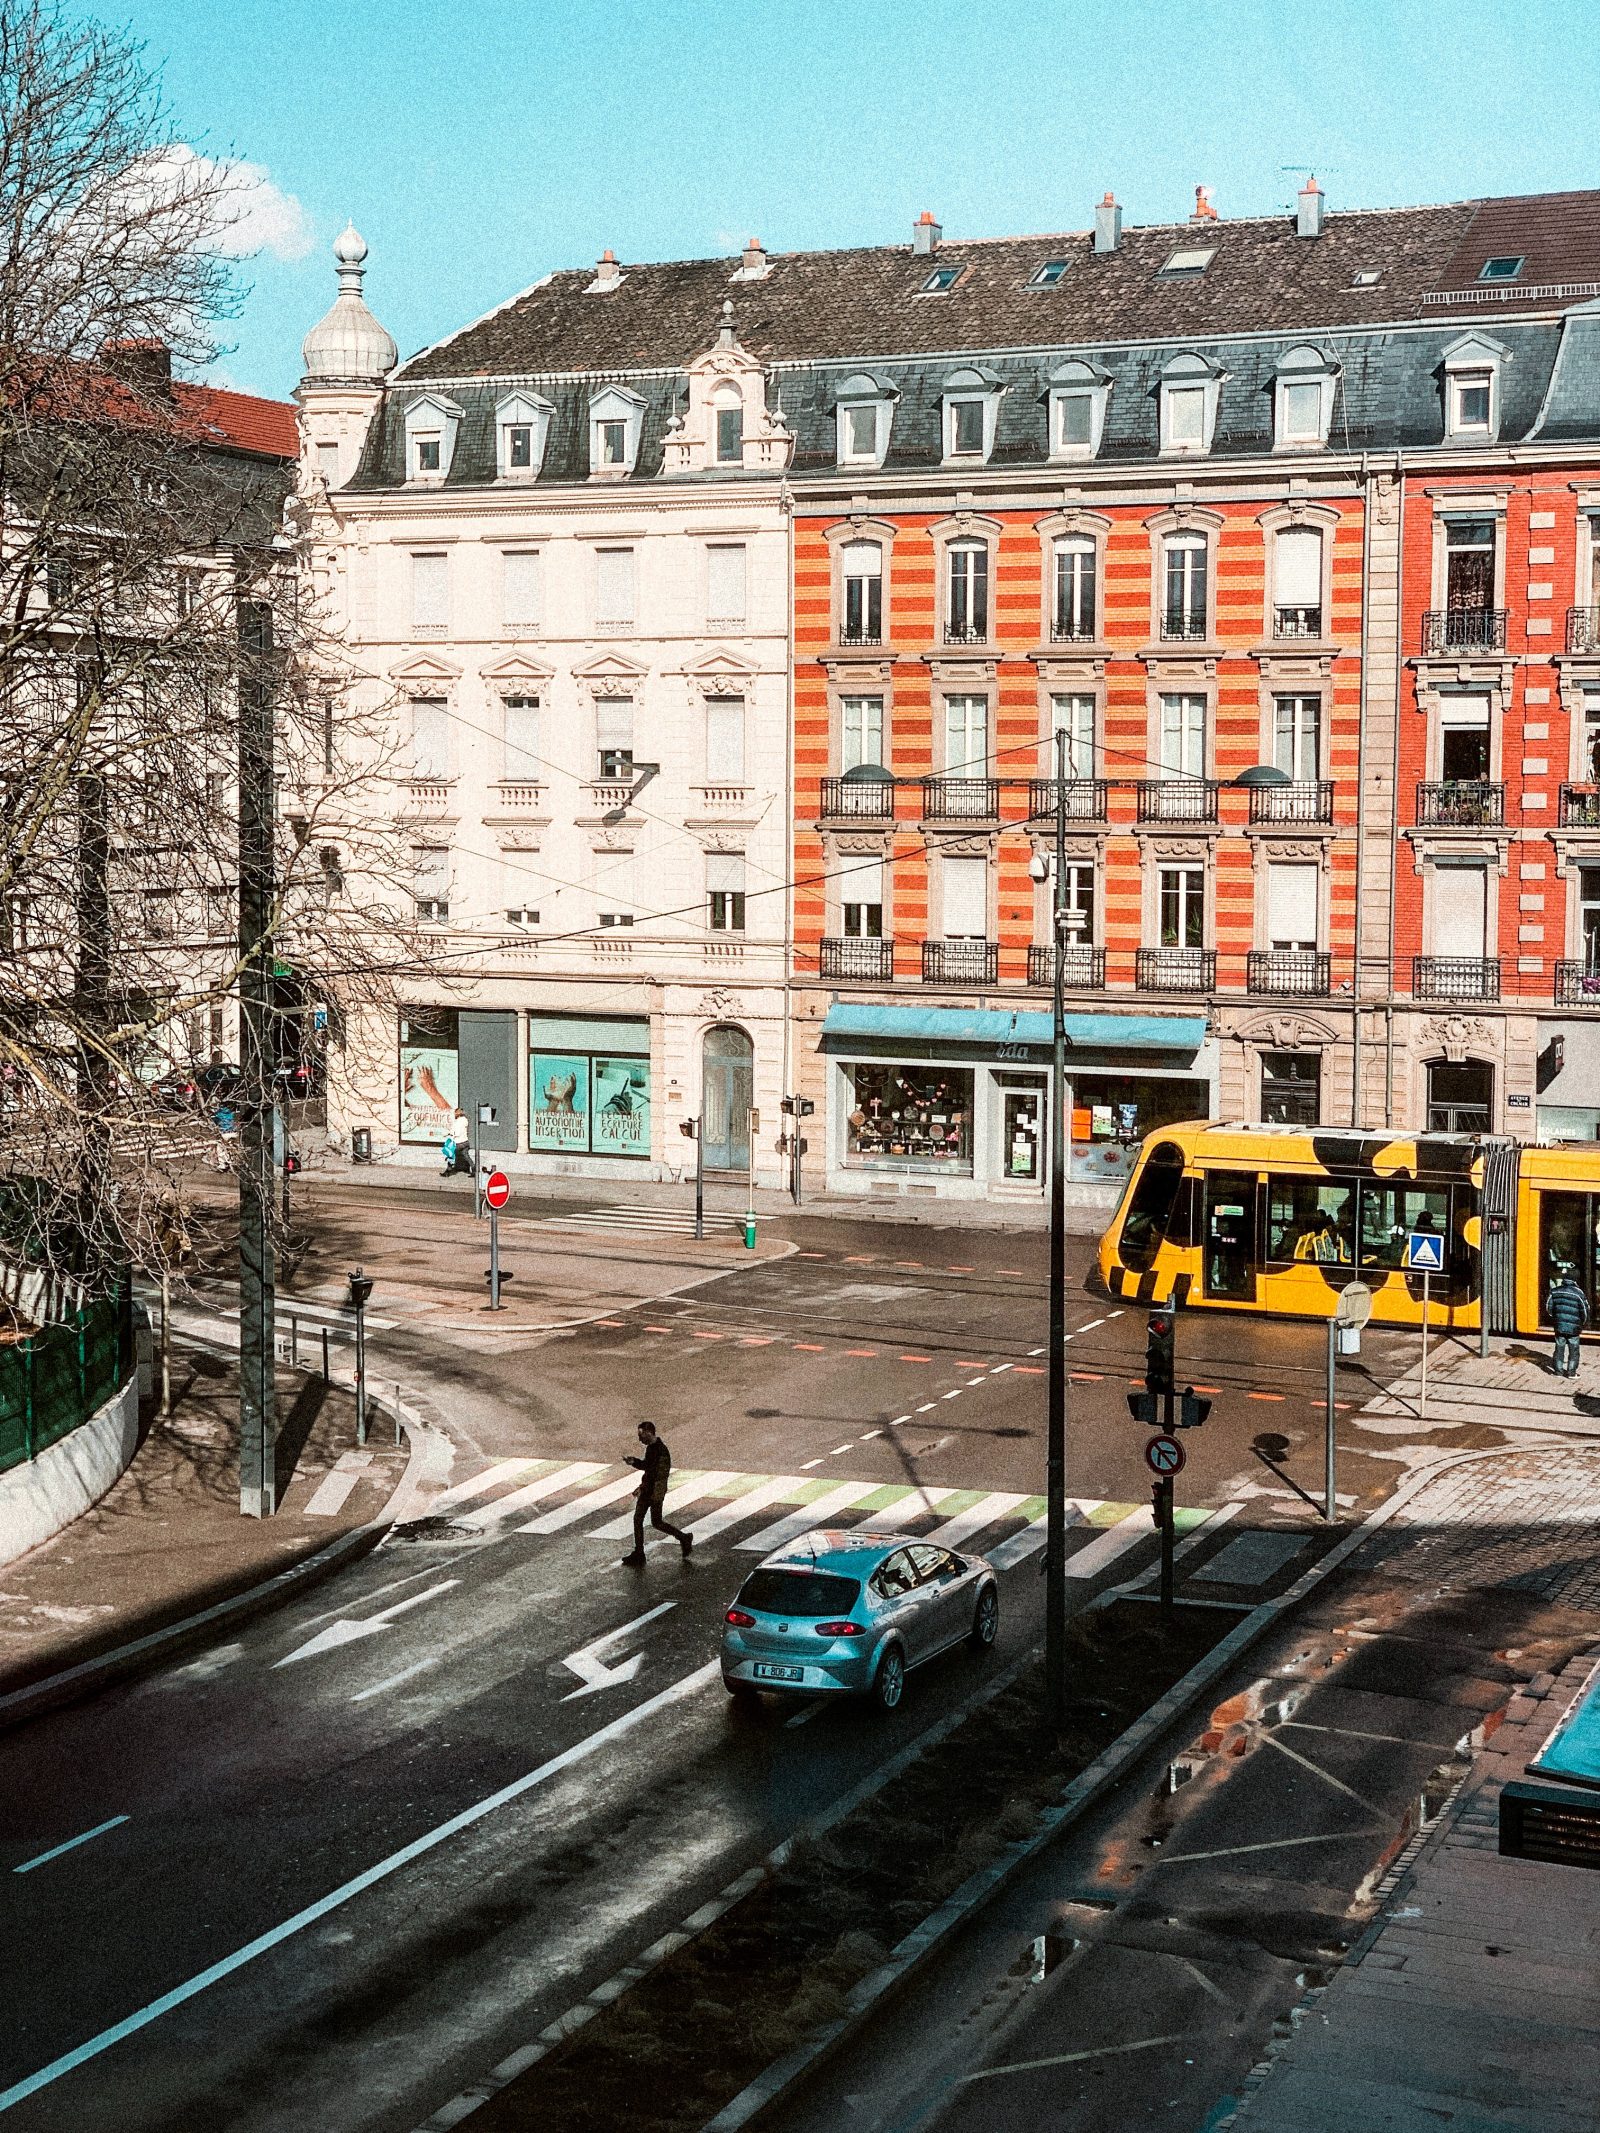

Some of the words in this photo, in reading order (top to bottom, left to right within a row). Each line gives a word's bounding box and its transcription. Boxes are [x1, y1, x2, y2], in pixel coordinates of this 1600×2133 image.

[535, 1117, 584, 1129] AUTONOMIE
[535, 1126, 585, 1138] INSERTION
[601, 1128, 641, 1140] CALCUL
